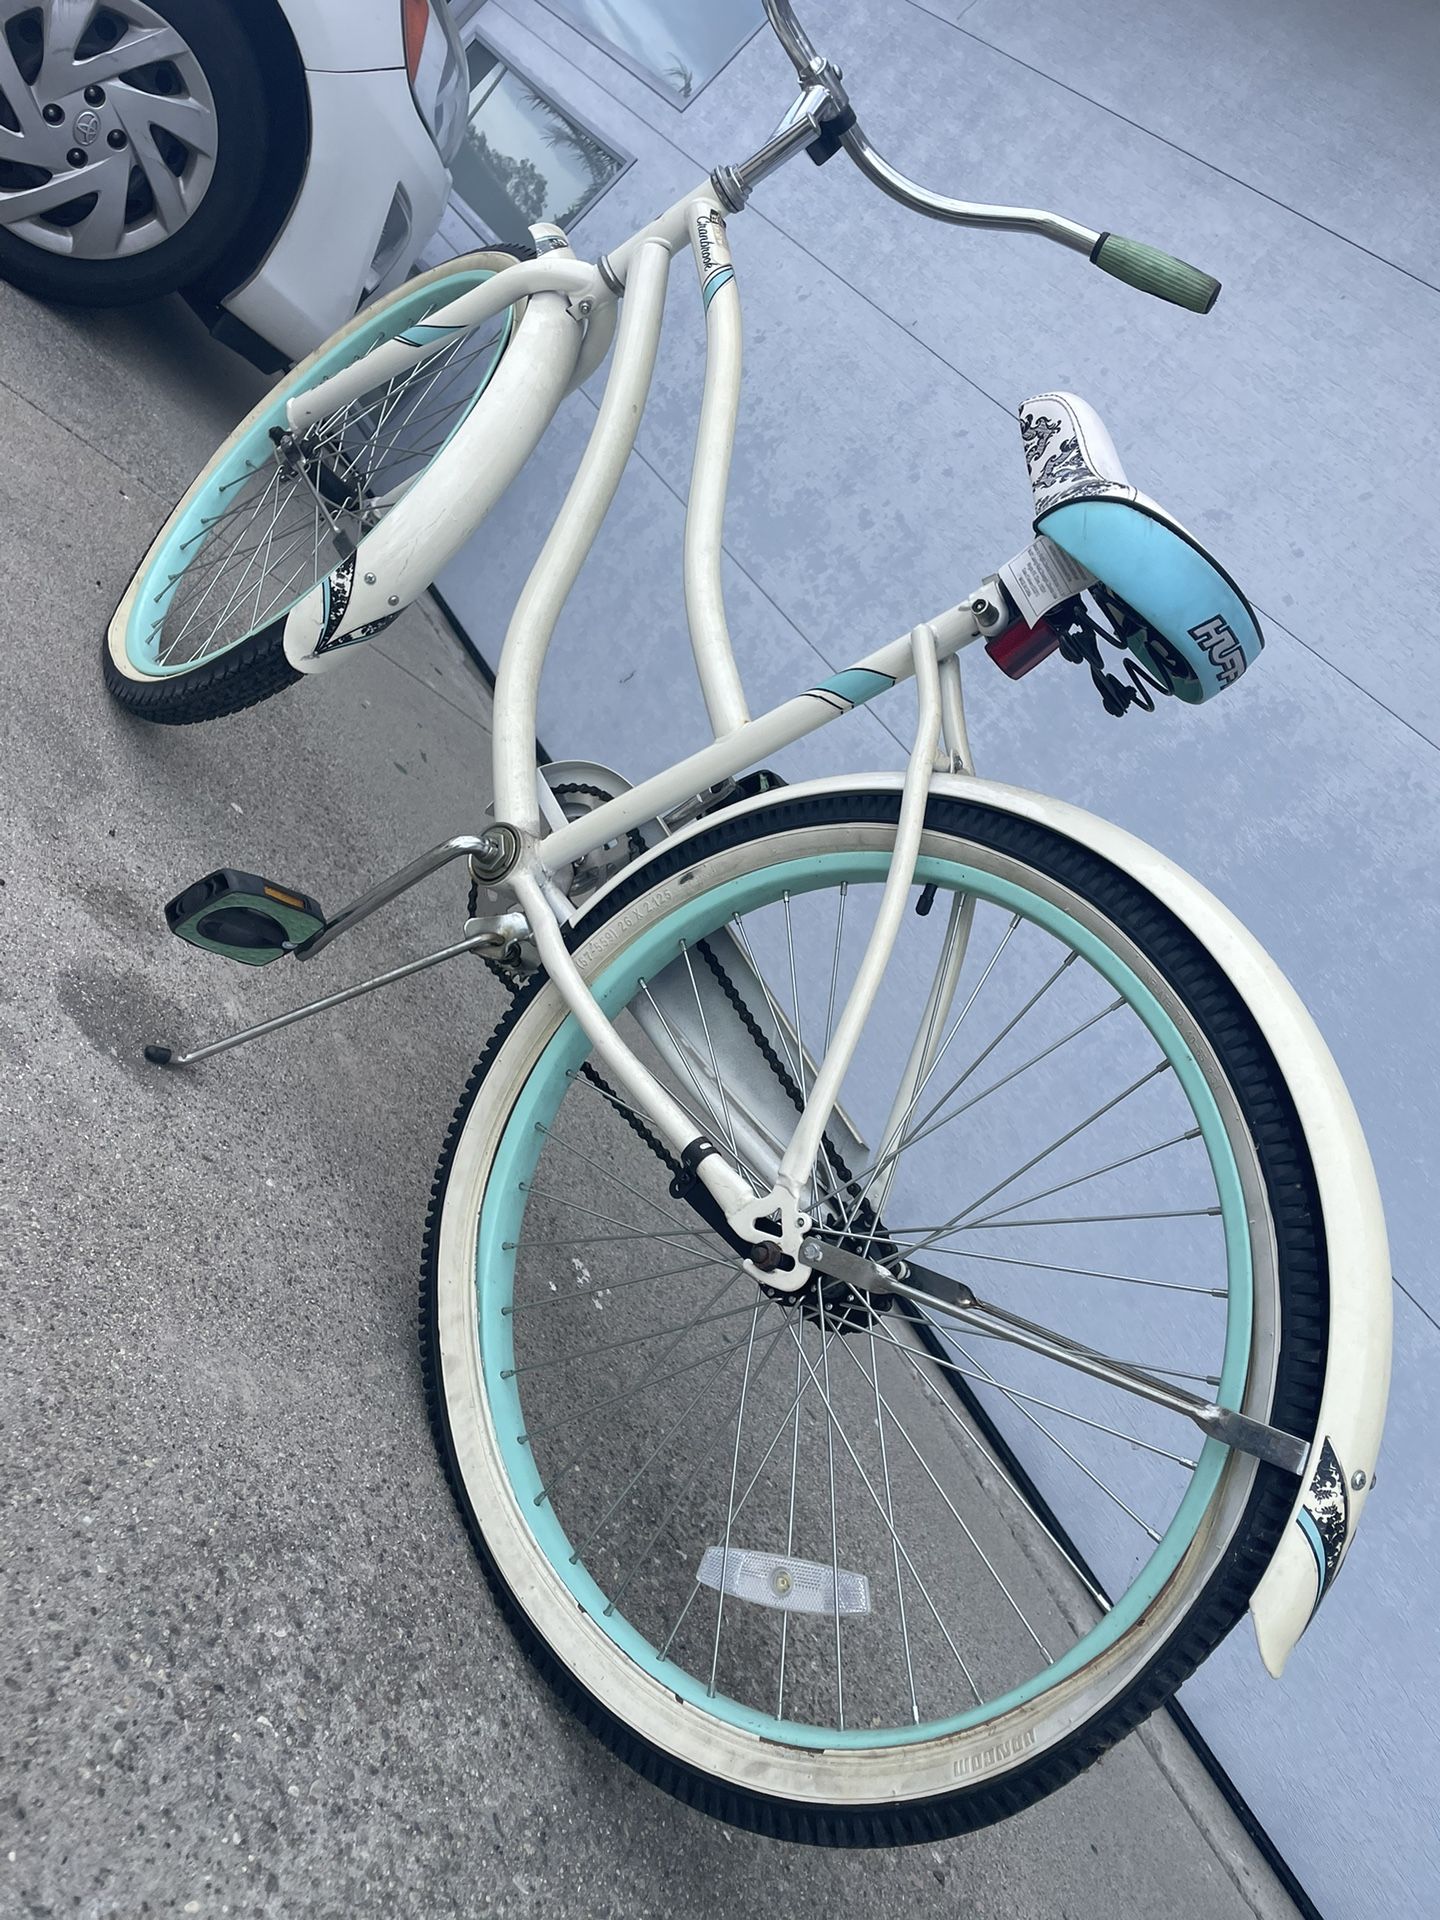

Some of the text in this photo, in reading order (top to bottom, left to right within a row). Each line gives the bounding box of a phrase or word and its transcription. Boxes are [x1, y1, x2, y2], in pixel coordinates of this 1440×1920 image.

[697, 216, 720, 272] Cranbrook
[1187, 613, 1247, 691] HUFF
[617, 916, 632, 932] 26
